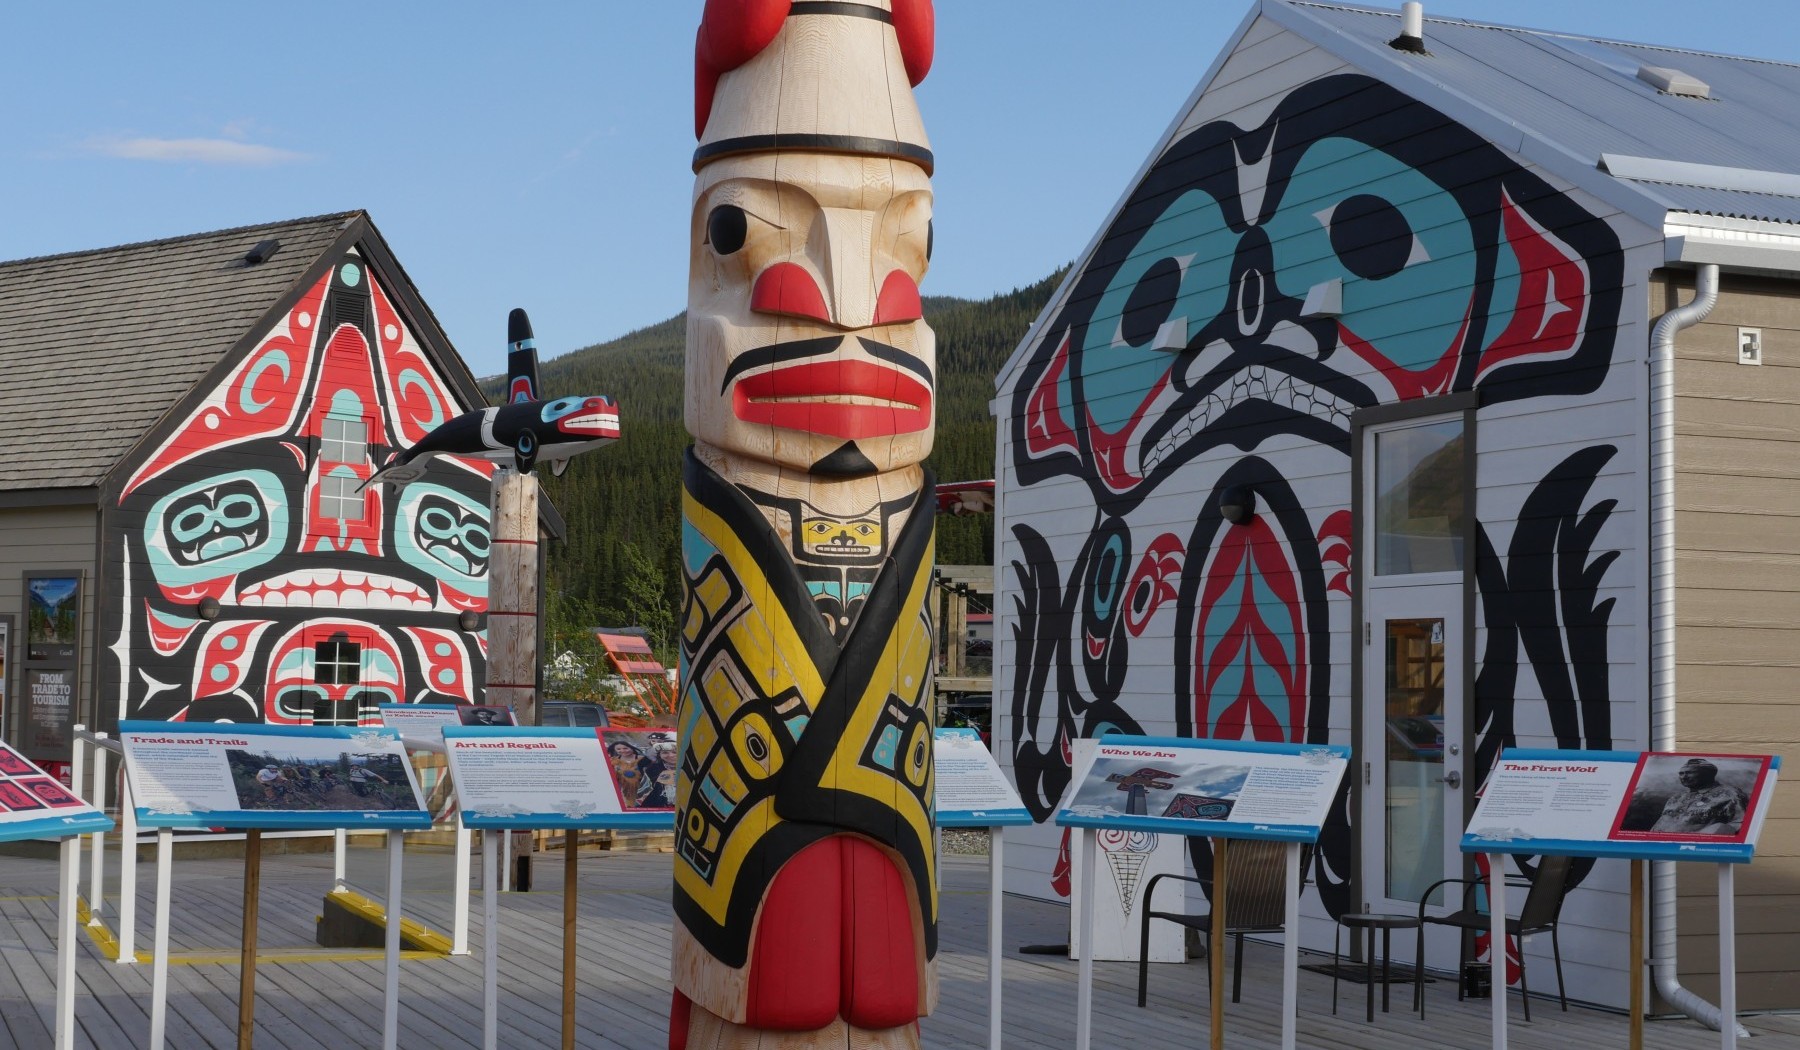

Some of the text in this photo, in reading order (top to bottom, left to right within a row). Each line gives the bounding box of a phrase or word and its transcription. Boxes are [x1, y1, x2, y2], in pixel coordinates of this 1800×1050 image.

[40, 673, 64, 684] FROM
[32, 684, 71, 695] TRADE TO
[32, 694, 69, 706] TOURISM
[130, 736, 175, 744] Trade
[205, 738, 249, 746] Trails
[507, 742, 557, 750] Regalia
[1101, 748, 1130, 756] Who
